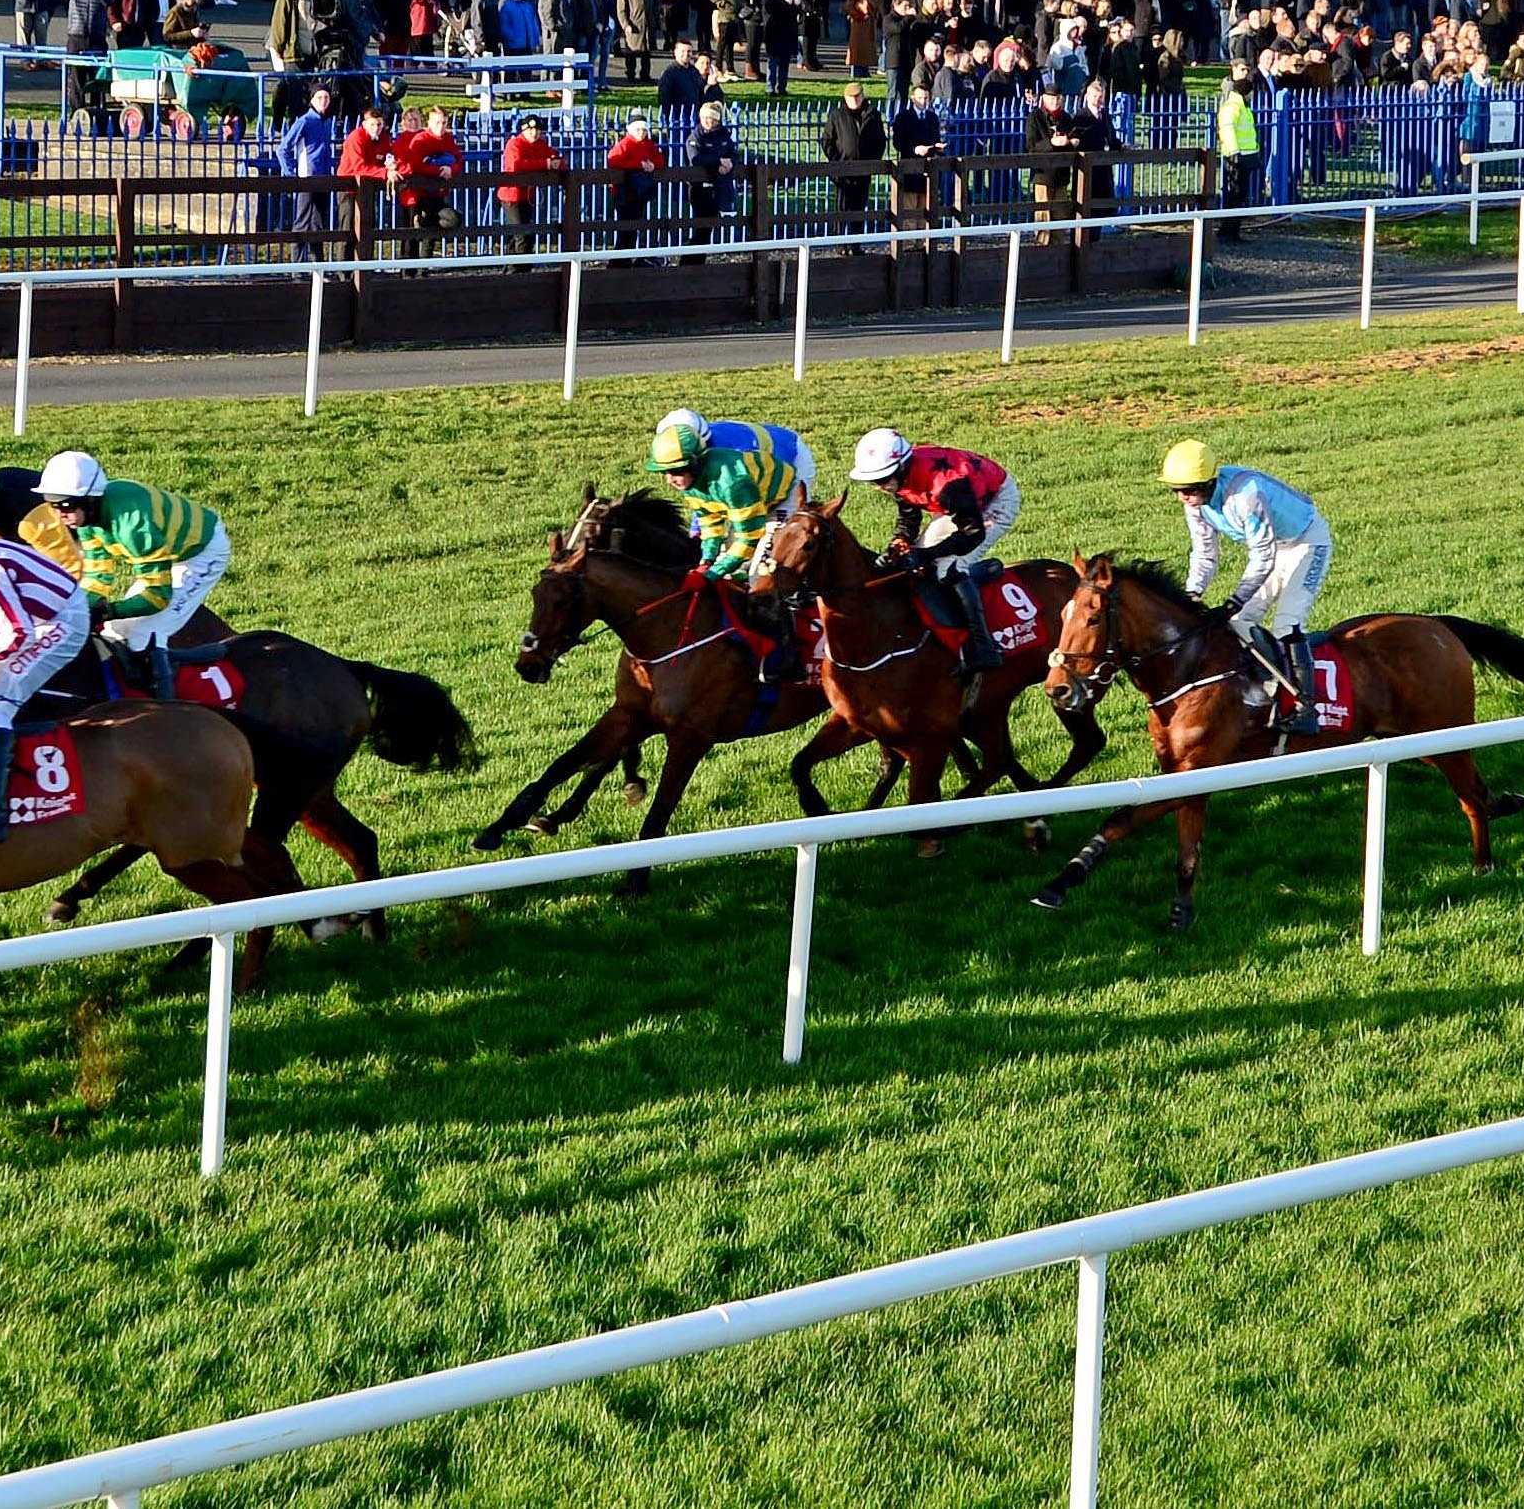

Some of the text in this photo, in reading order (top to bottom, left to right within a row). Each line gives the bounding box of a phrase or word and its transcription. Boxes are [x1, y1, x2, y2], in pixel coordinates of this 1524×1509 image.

[1001, 582, 1038, 621] 9
[200, 666, 233, 701] 1
[1314, 659, 1337, 701] 7
[33, 745, 70, 793] 8
